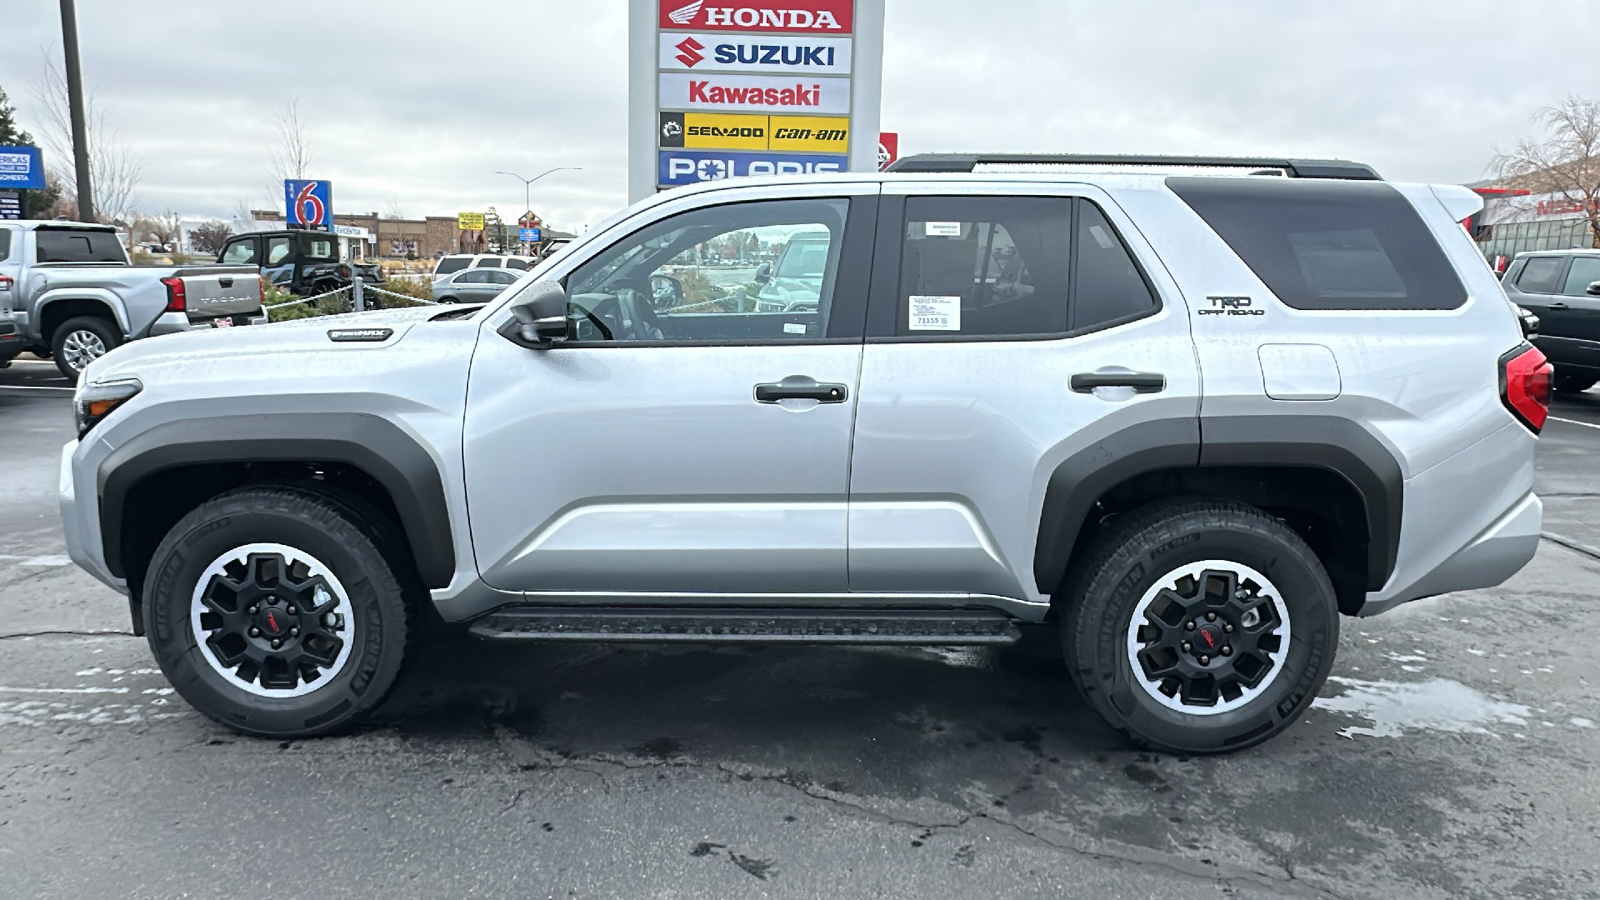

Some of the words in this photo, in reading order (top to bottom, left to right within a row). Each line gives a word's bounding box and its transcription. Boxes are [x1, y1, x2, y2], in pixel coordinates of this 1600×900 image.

[705, 7, 841, 29] HONDA
[714, 44, 835, 66] SUZUKI
[689, 80, 820, 106] Kawasaki
[295, 182, 324, 226] 6
[1206, 296, 1252, 309] TRD
